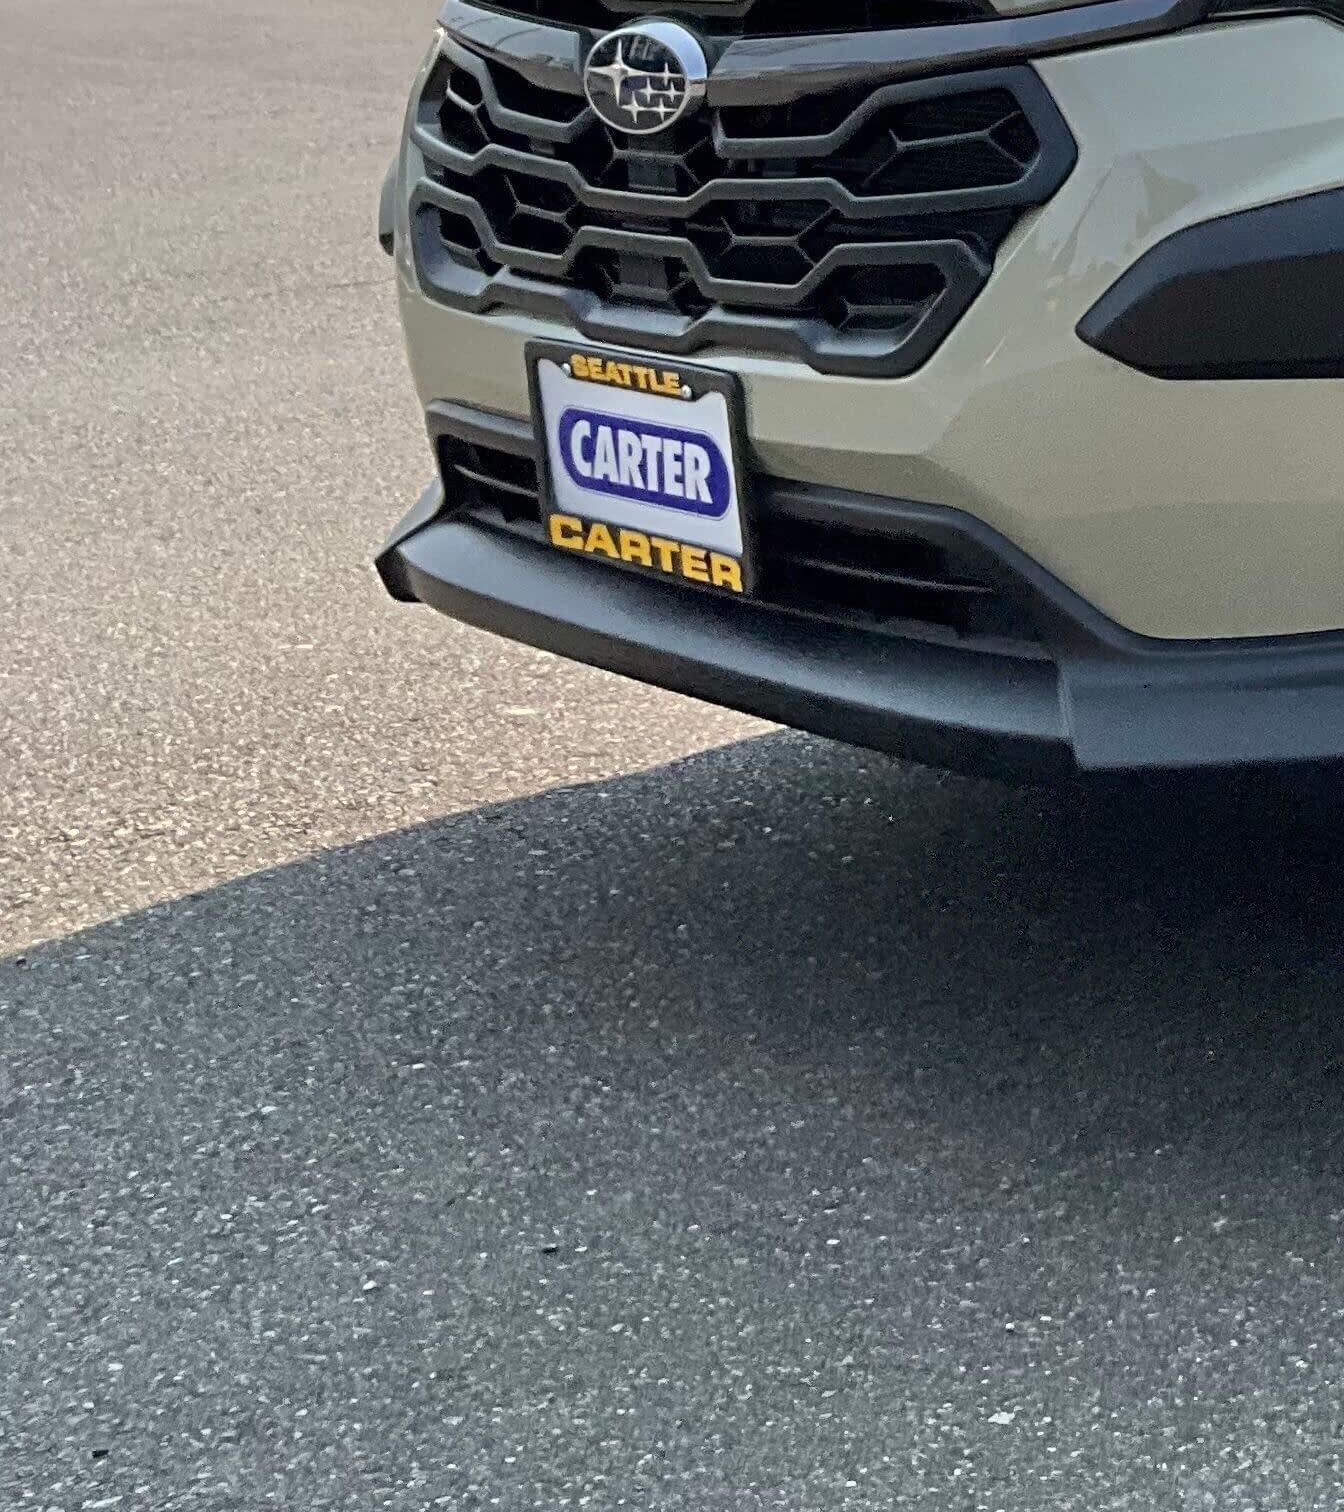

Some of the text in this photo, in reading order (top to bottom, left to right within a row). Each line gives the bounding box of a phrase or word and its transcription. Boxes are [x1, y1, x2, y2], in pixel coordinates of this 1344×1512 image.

[569, 353, 684, 396] SEATTLE
[570, 419, 713, 505] CARTER
[550, 513, 743, 594] CARTER
